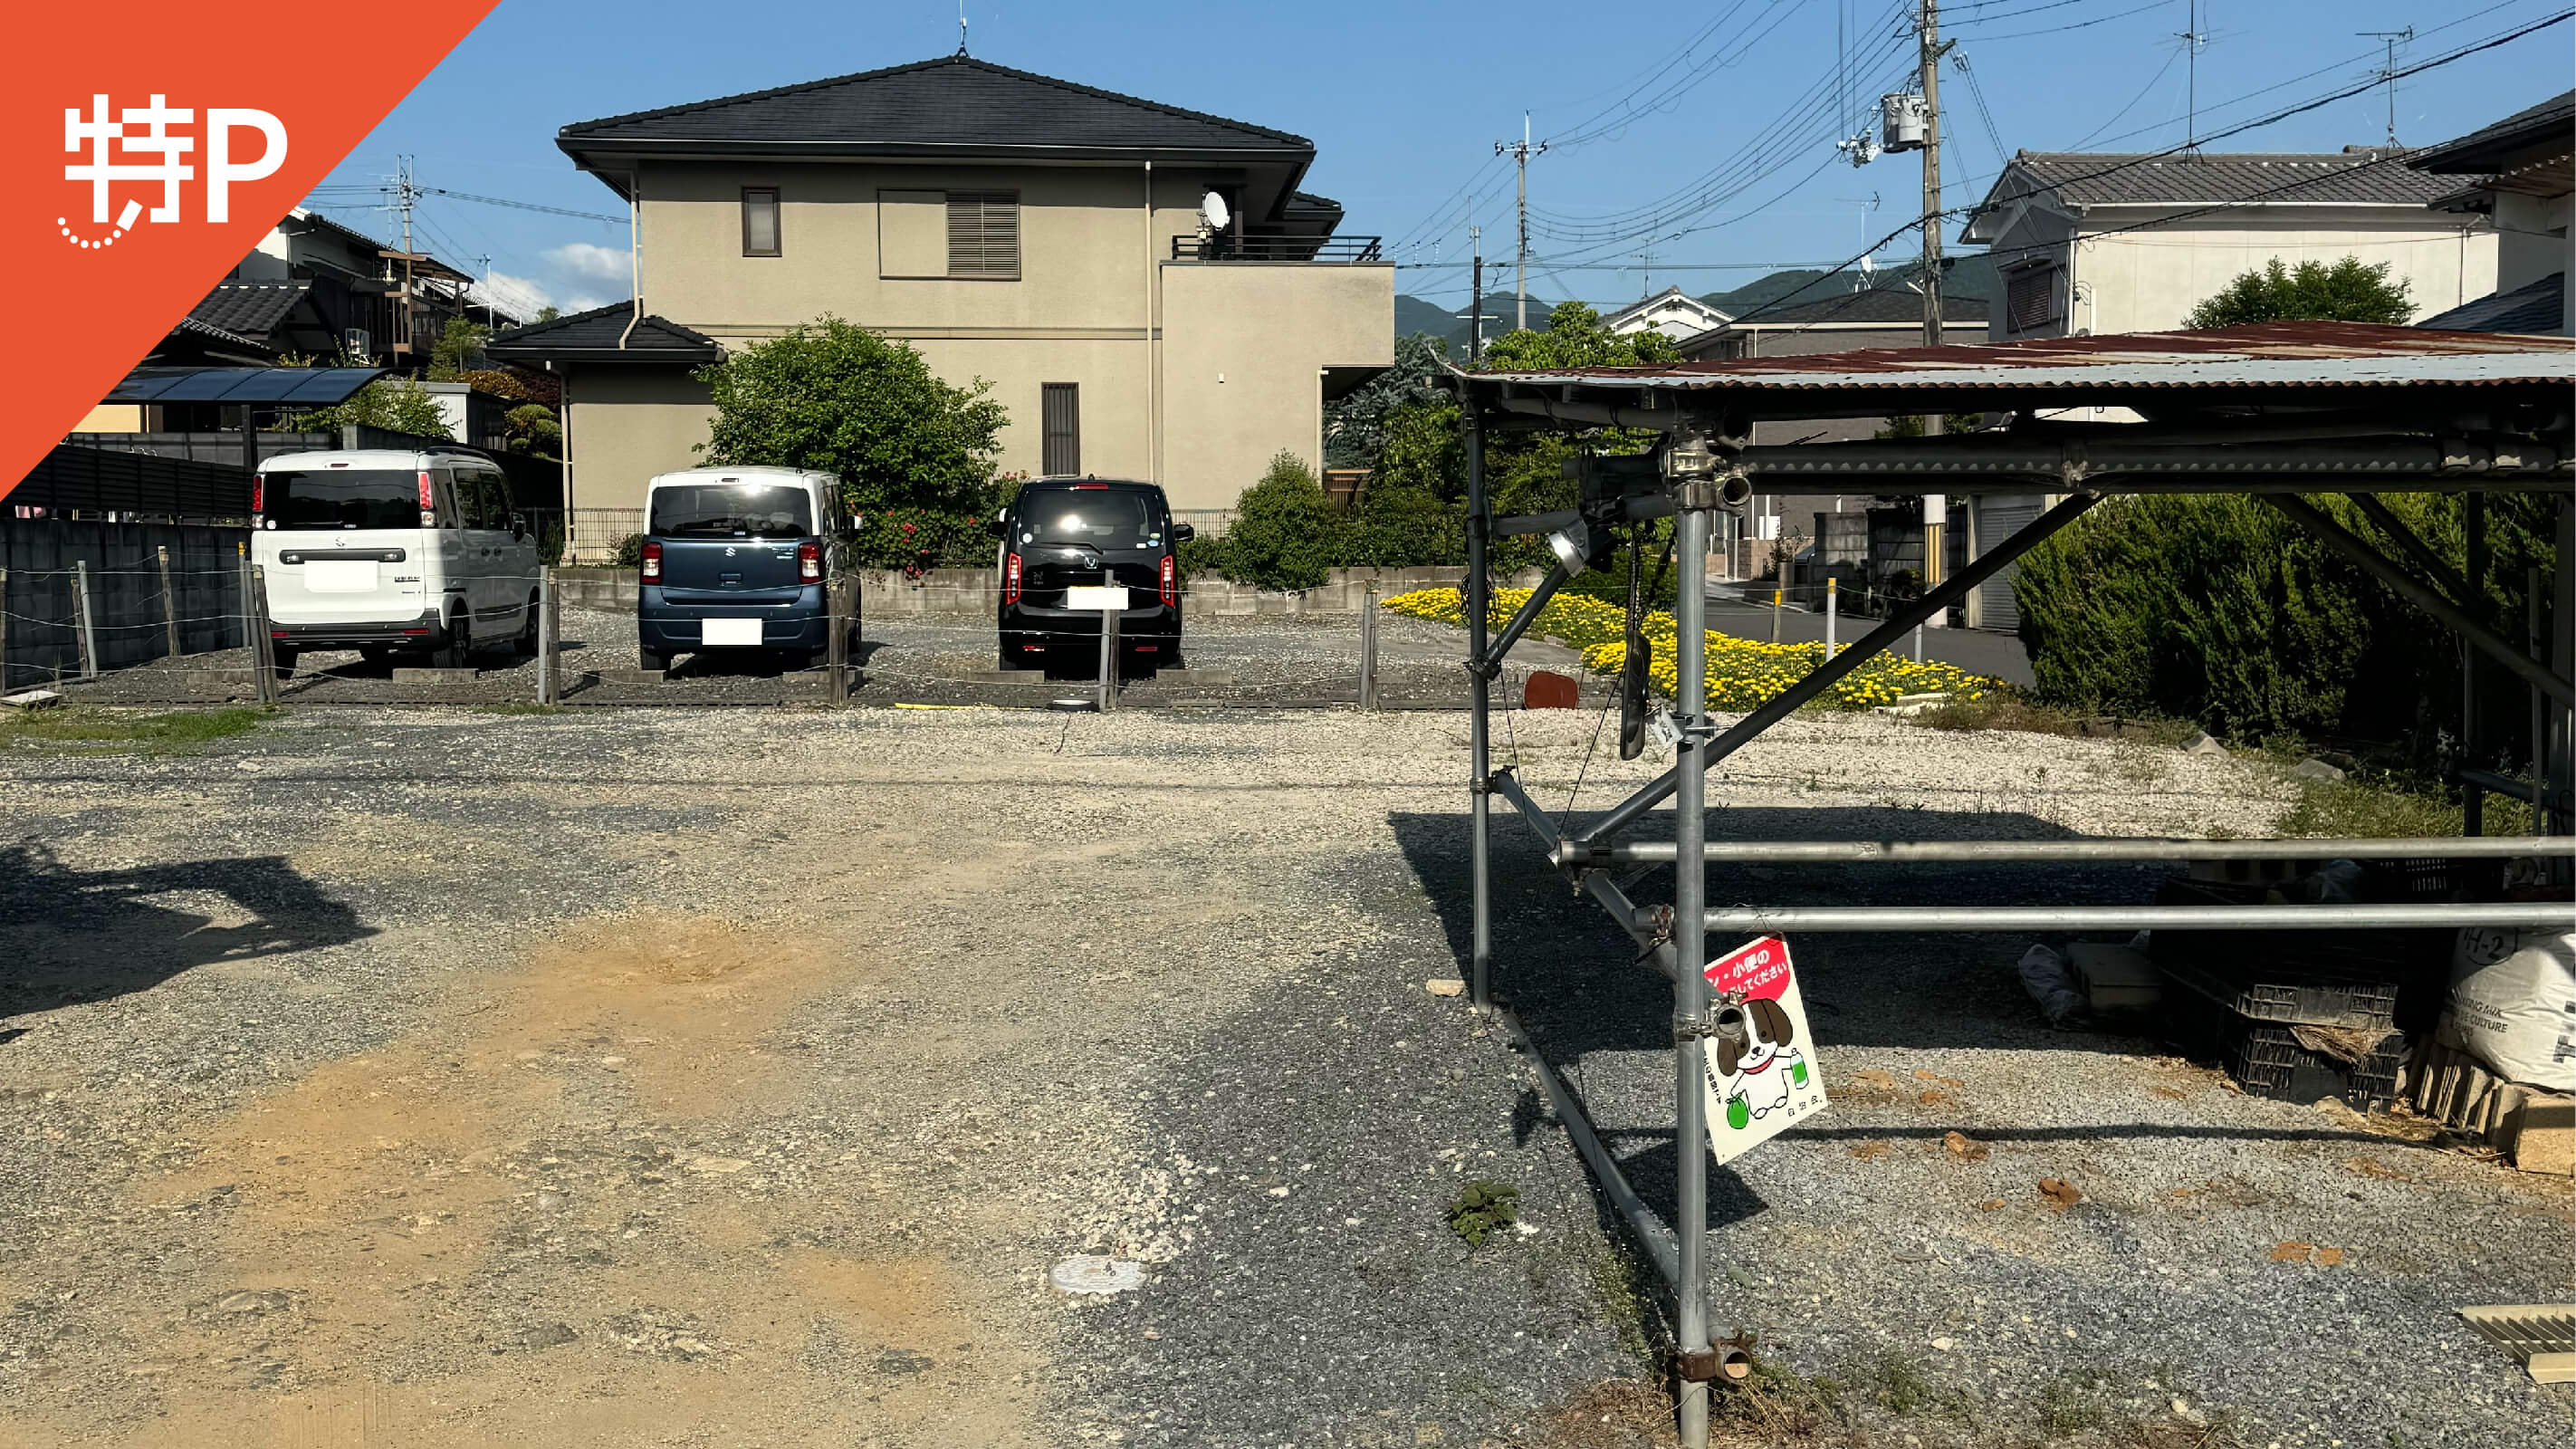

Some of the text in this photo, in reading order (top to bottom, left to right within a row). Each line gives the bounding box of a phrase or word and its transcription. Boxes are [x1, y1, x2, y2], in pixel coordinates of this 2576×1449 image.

[1722, 961, 1787, 997] してください
[2470, 1013, 2508, 1033] CULTURE
